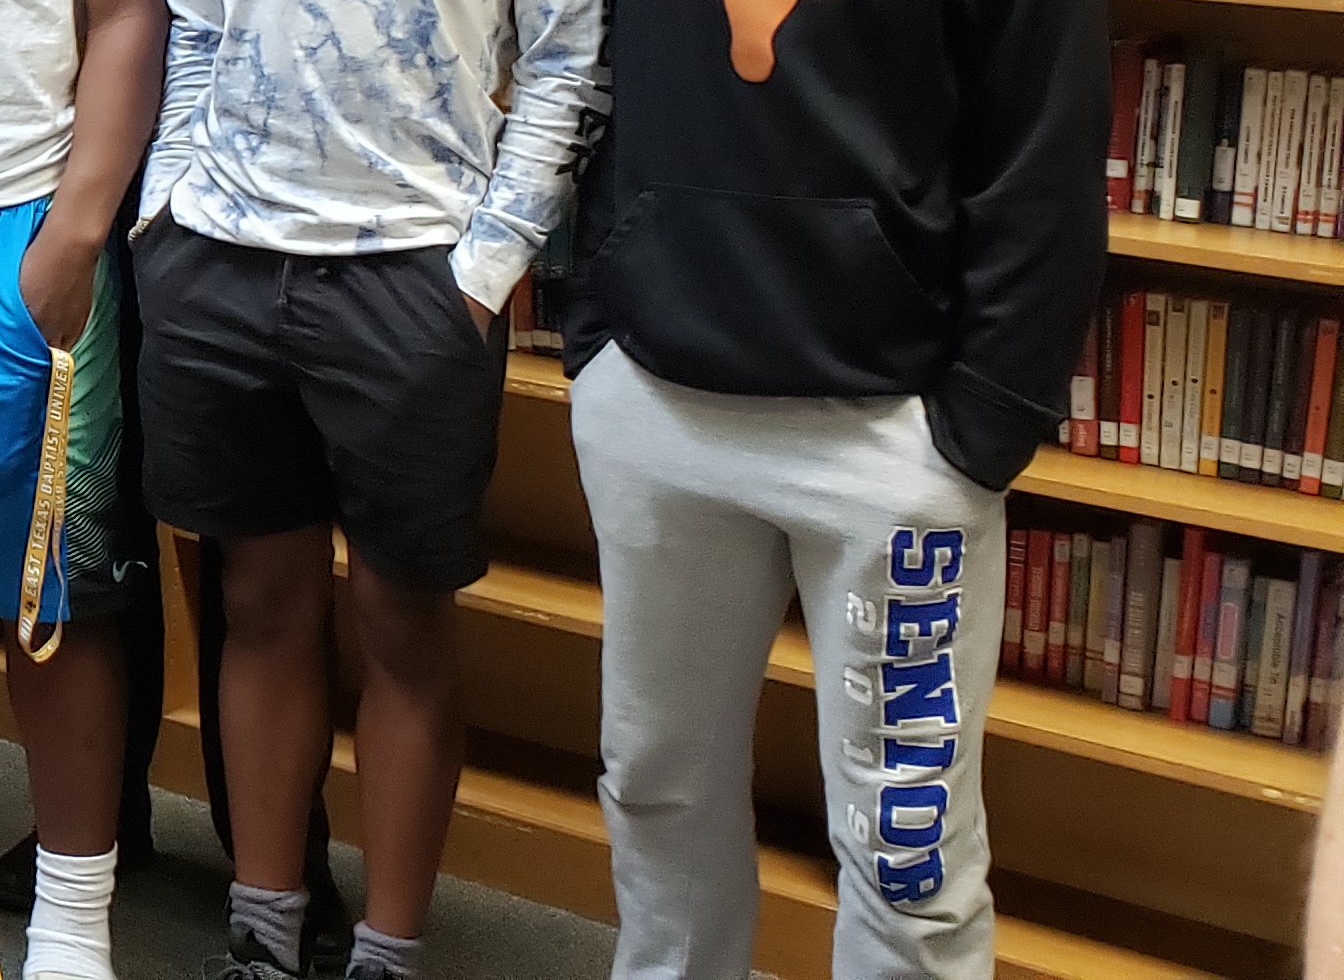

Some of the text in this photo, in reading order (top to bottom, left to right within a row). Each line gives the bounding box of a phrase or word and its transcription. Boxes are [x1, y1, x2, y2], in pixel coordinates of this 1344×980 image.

[50, 350, 70, 421] UNIVERS
[40, 426, 62, 495] BAPTIST
[32, 497, 51, 551] TEXAS
[24, 555, 42, 598] EAST
[1270, 612, 1286, 670] Acceptable
[843, 590, 877, 847] 2019
[874, 525, 965, 907] SENIOR
